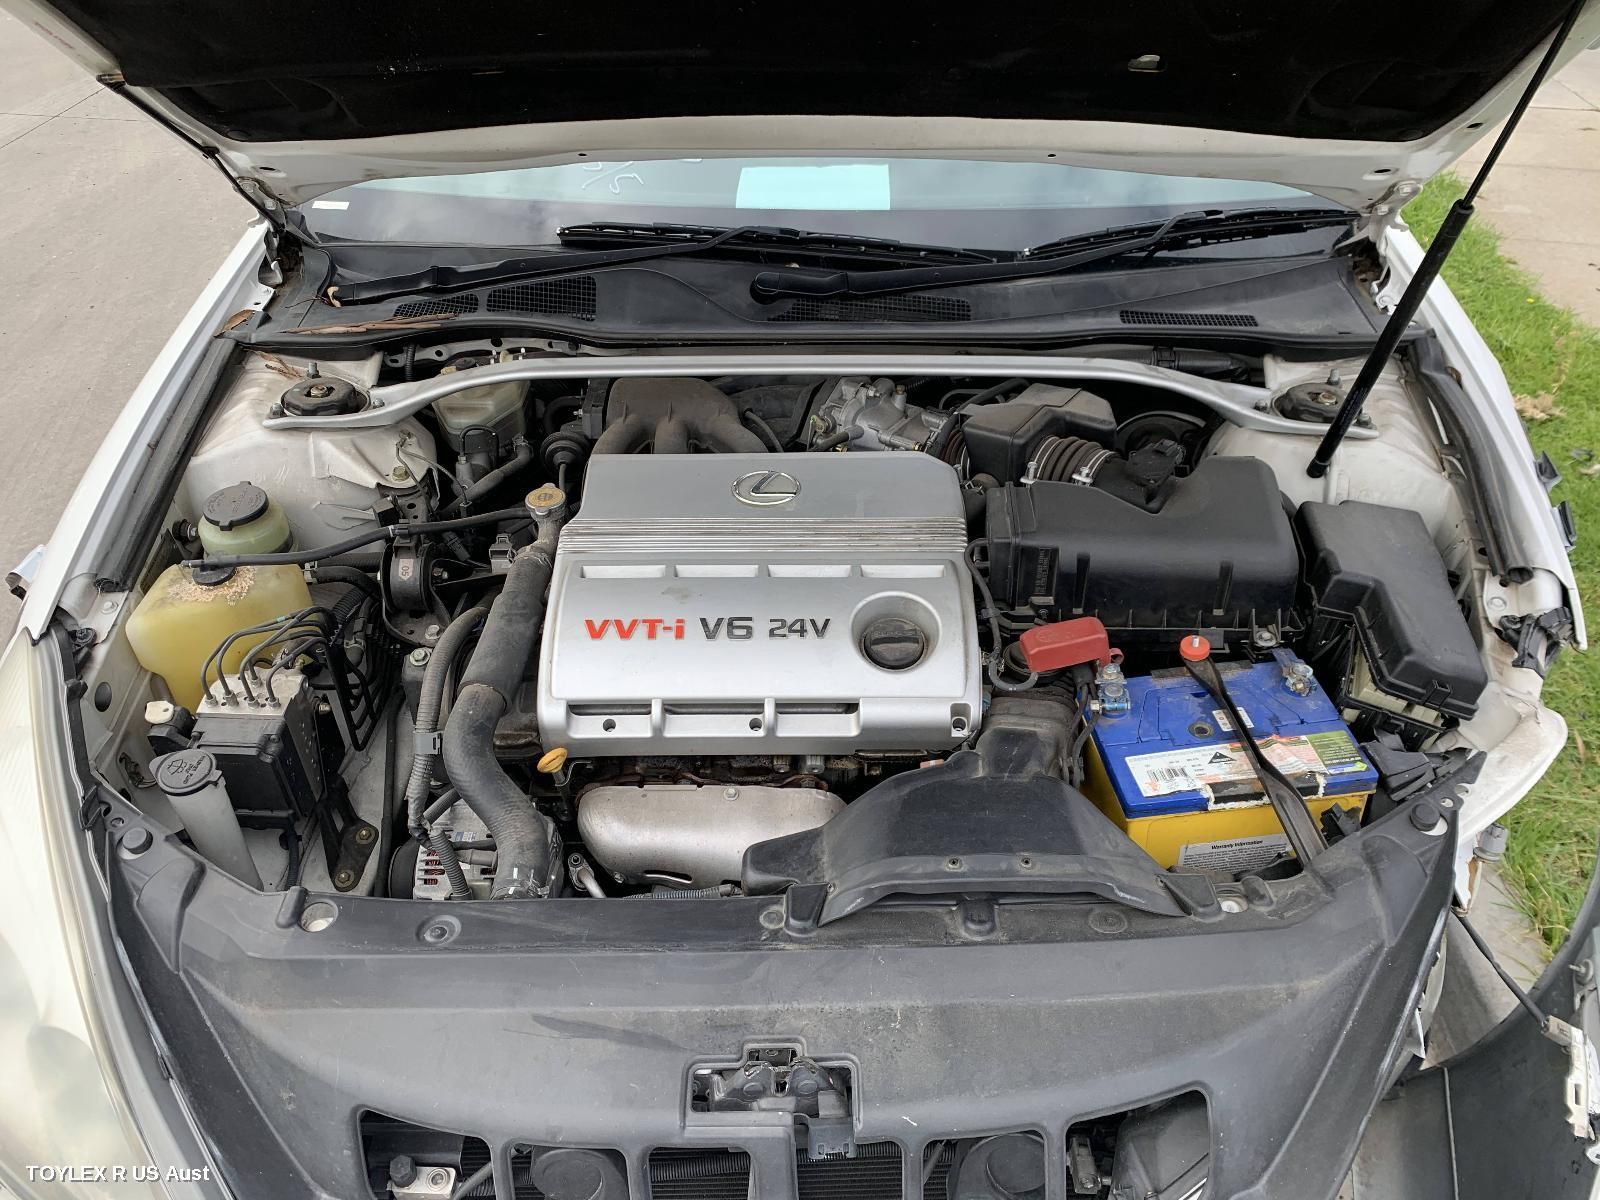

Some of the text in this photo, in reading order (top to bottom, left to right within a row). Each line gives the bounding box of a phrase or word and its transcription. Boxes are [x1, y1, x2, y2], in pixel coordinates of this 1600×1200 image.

[584, 616, 831, 640] VVT-i V6 24V
